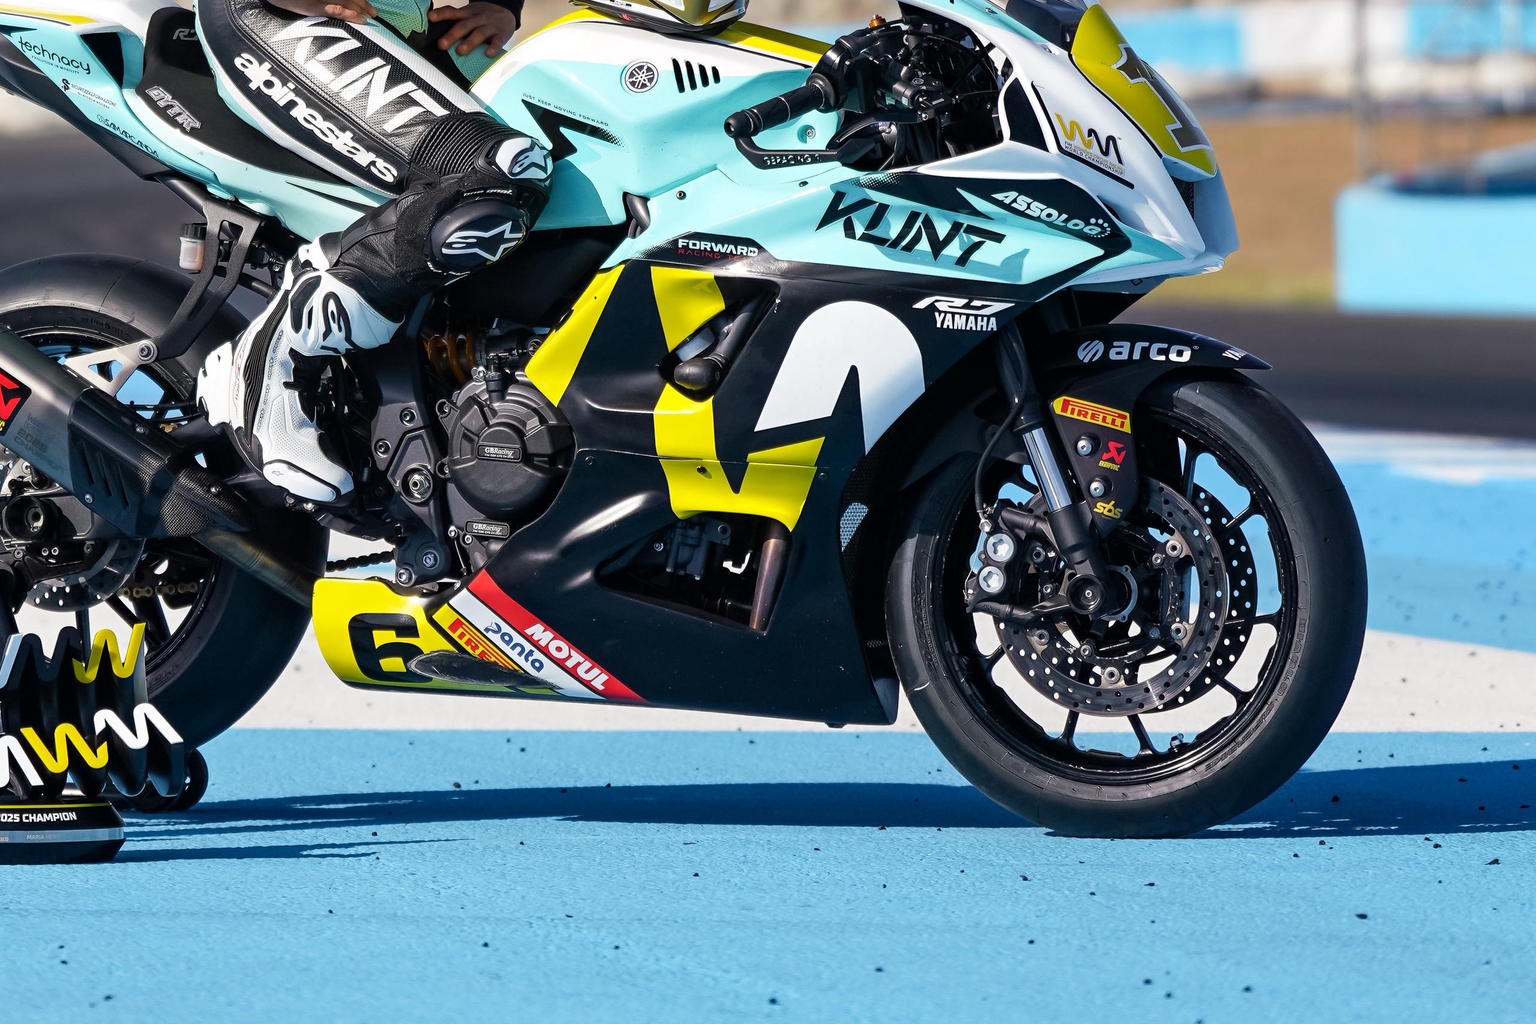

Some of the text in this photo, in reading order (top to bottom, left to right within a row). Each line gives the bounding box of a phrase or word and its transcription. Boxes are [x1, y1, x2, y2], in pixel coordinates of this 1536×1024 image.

[18, 36, 91, 75] technacy
[270, 17, 450, 133] KLINT
[234, 52, 398, 183] alpinestars
[537, 98, 551, 106] KEEP
[553, 105, 576, 116] MOVING
[578, 114, 609, 126] FORWARD
[1064, 145, 1124, 175] WORLD CHAMPIONSHIP
[814, 189, 1007, 268] KLINT
[677, 249, 721, 259] RACING
[678, 238, 759, 257] FORWARD
[912, 295, 1015, 315] R7
[934, 311, 997, 332] YAMAHA
[1108, 340, 1192, 363] arco
[1061, 398, 1127, 429] PIRELLI
[348, 613, 433, 683] 6
[448, 617, 516, 671] PIRE
[525, 623, 609, 691] MOTUL
[22, 811, 78, 823] CHAMPION
